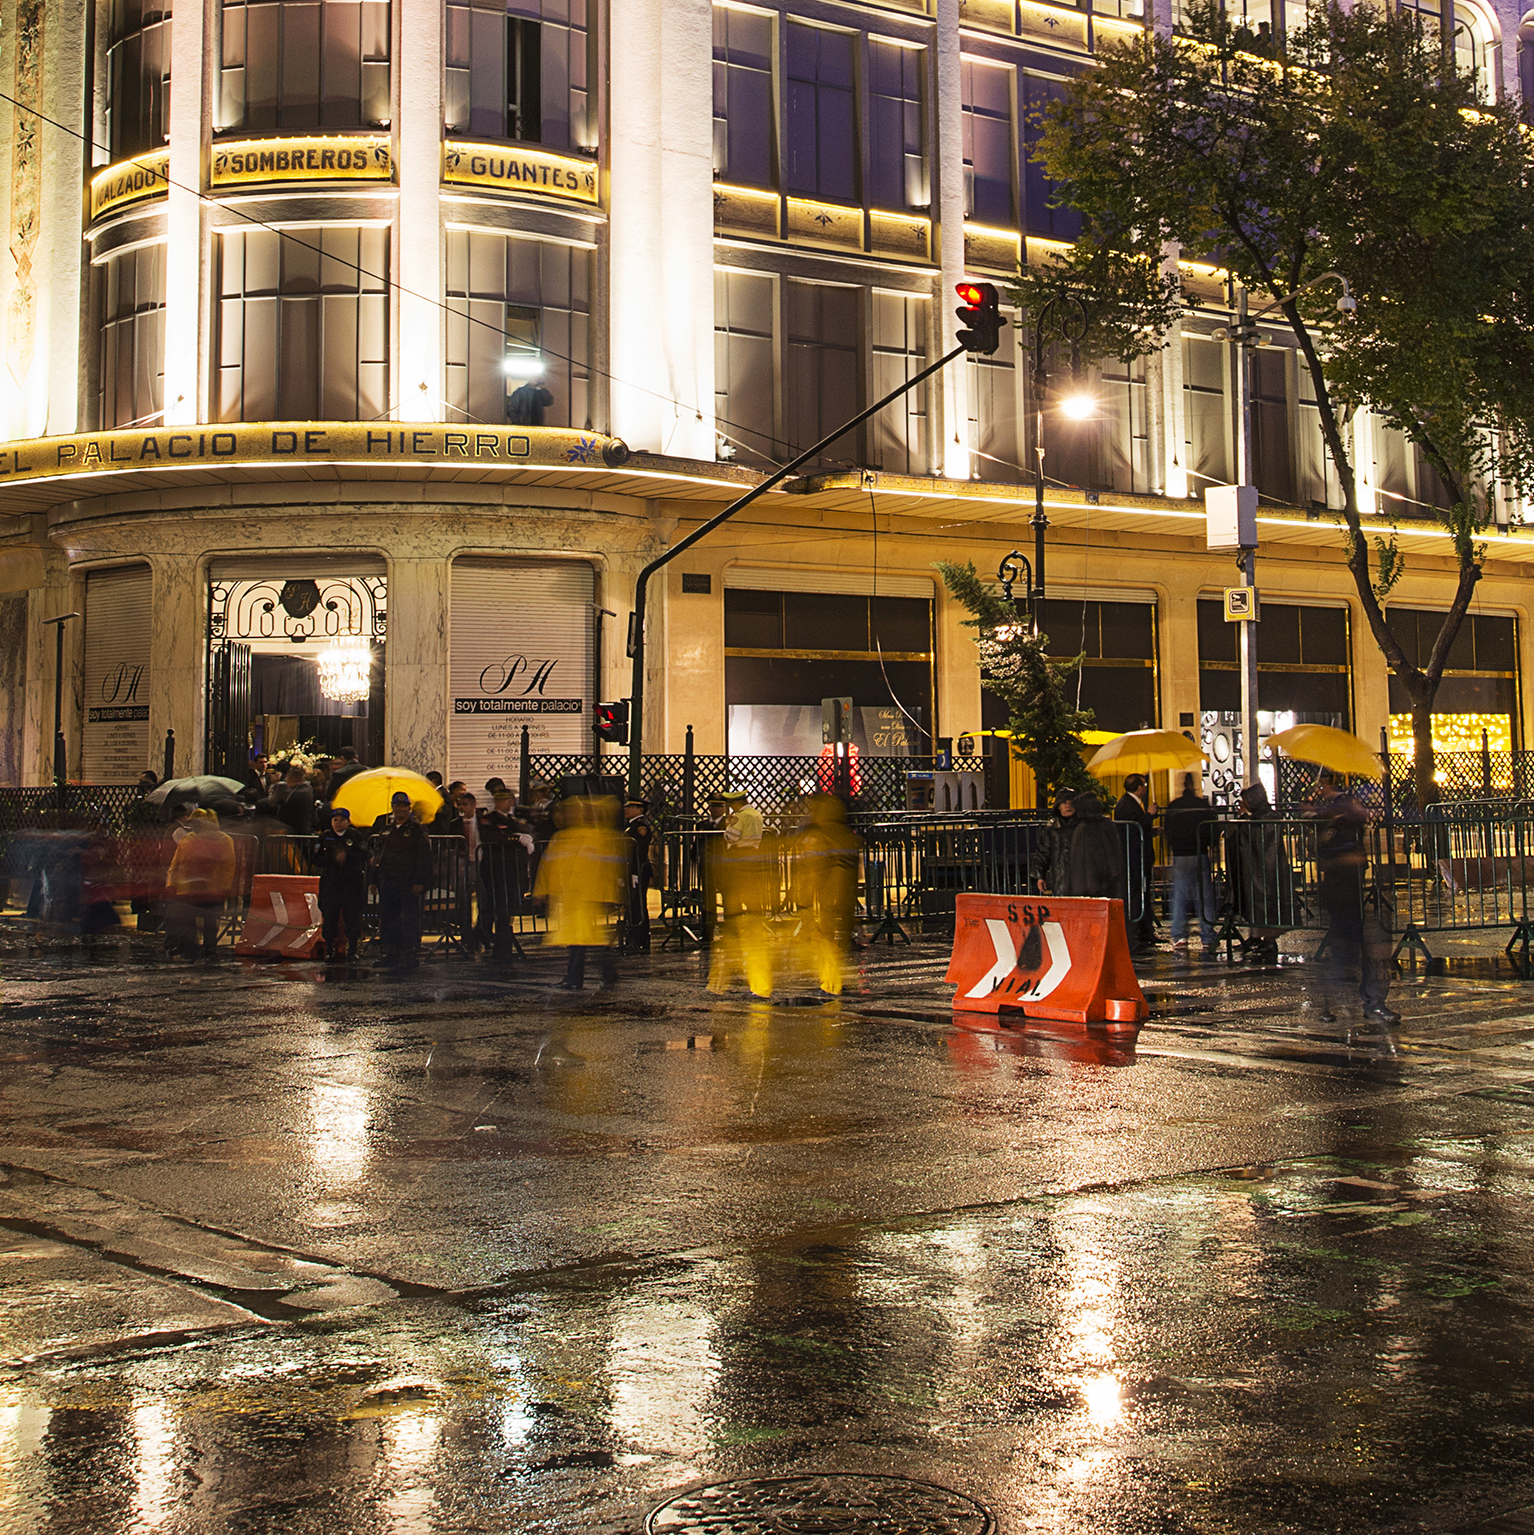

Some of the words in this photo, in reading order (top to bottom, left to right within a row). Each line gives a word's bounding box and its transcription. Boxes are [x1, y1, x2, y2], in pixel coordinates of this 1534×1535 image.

[231, 149, 368, 174] SOMBREROS
[471, 156, 579, 190] GUANTES
[98, 167, 156, 207] CALZADO
[57, 433, 237, 467] PALACIO
[271, 431, 331, 454] DE
[367, 430, 532, 458] HIERRO
[89, 709, 100, 722] soy
[101, 707, 132, 719] totalmente
[133, 706, 149, 720] palac
[455, 700, 477, 713] soy
[479, 699, 539, 711] totalmente
[1007, 902, 1051, 927] SSP
[991, 976, 1041, 997] VIAL
